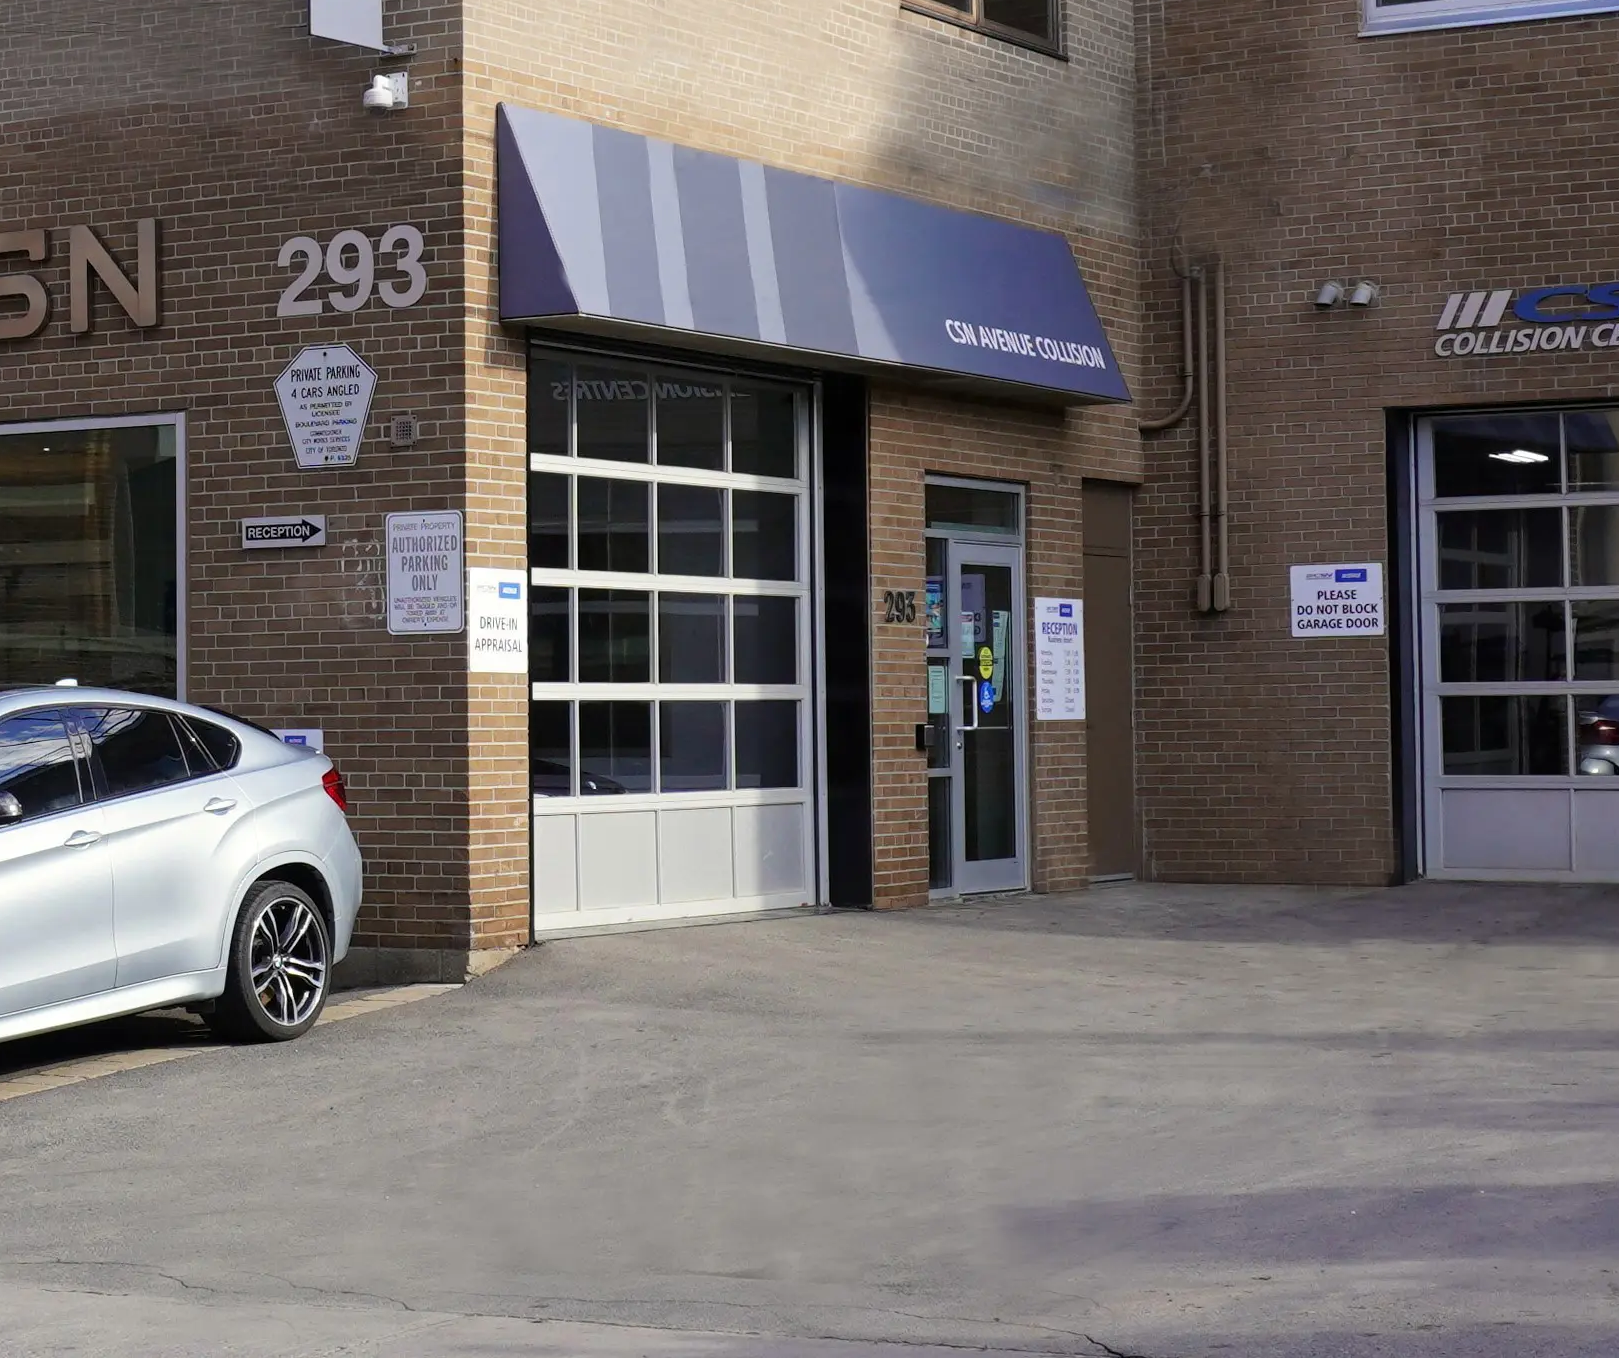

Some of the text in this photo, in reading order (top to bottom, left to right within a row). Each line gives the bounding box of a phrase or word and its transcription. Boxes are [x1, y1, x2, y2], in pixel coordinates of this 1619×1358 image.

[277, 225, 426, 317] 293
[945, 319, 1106, 369] CSN AVENUE COLLISION
[1434, 326, 1587, 357] COLLISION
[290, 364, 360, 382] PRIVATE PARKING
[291, 384, 360, 399] 4 CARS ANGLED
[247, 525, 310, 539] RECEPTION
[393, 521, 456, 531] PRIVATE PROPERTY
[392, 535, 458, 553] AUTHORIZED
[401, 554, 448, 572] PARKING
[412, 574, 438, 591] ONLY
[1317, 589, 1357, 600] PLEASE
[884, 590, 916, 623] 293
[1297, 603, 1378, 615] DO NOT BLOCK
[479, 616, 518, 631] DRIVE-IN
[1042, 622, 1078, 635] RECEPTION
[1297, 617, 1379, 629] GARAGE DOOR
[475, 638, 522, 653] APPRAISAL
